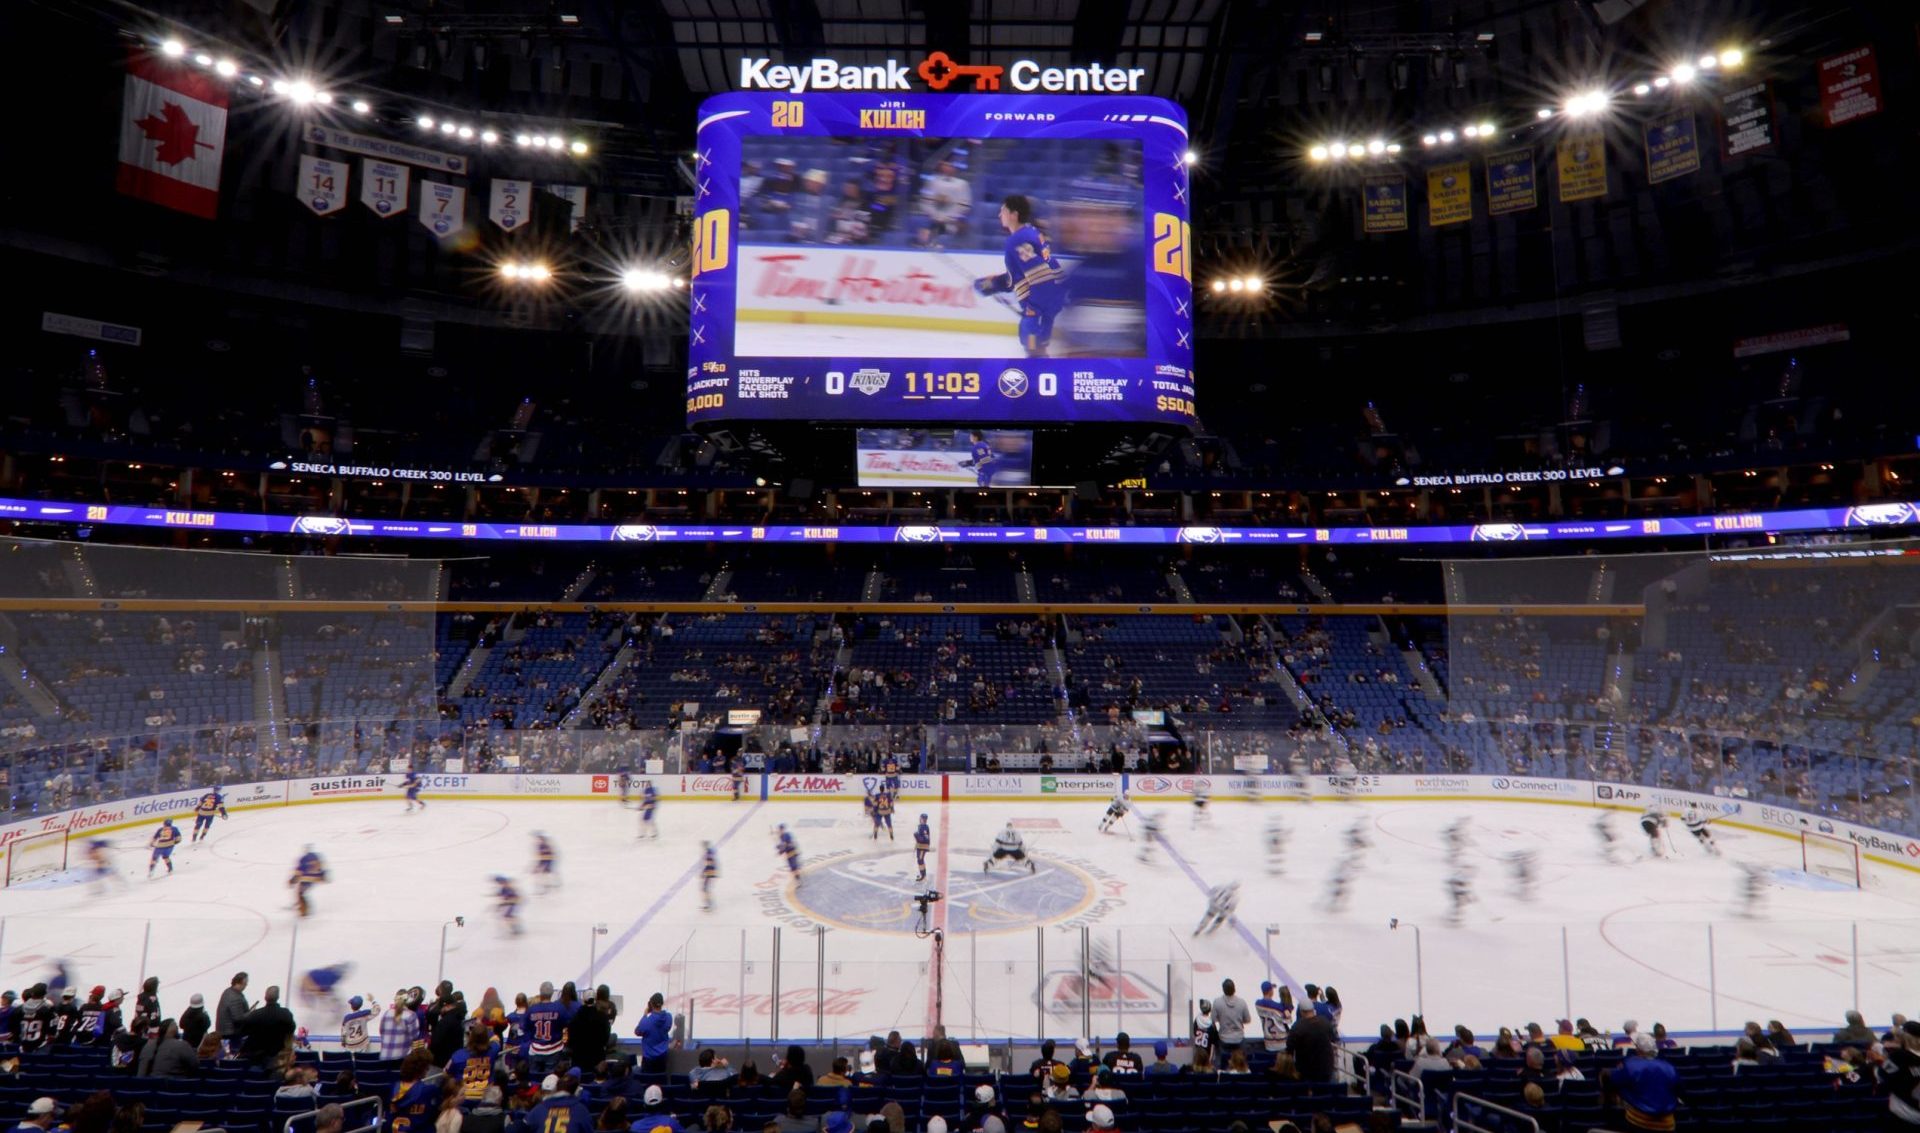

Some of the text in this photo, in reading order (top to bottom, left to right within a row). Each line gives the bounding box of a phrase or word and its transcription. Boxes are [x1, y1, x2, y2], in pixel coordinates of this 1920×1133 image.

[741, 58, 1144, 93] KeyBank Center
[772, 101, 803, 127] 20
[860, 110, 925, 129] KULICH
[985, 113, 1055, 121] FORWARD
[312, 175, 334, 192] 14
[376, 178, 396, 194] 11
[437, 199, 449, 213] 7
[503, 195, 517, 209] 2
[739, 369, 760, 377] HITS
[693, 378, 729, 390] JACKPOT
[826, 372, 844, 395] 0
[853, 378, 886, 386] KINGS
[906, 372, 980, 393] 11:03
[1039, 373, 1057, 396] 0
[1152, 381, 1180, 391] TOTAL
[292, 463, 485, 481] SENECA BUFFALO CREEK 300 LEVEL
[1414, 468, 1604, 485] SENECA BUFFALO CREEK 300 LEVEL
[87, 506, 107, 520] 20
[166, 512, 215, 526] KULICH
[1714, 515, 1763, 529] KULICH
[462, 525, 476, 536] 20
[519, 526, 557, 537] KULICH
[752, 527, 765, 539] 20
[804, 528, 838, 539] KULICH
[1034, 528, 1047, 540] 20
[1086, 528, 1120, 540] KULICH
[1316, 529, 1329, 541] 20
[1371, 529, 1407, 540] KULICH
[310, 776, 385, 791] austin air
[433, 777, 468, 787] CFBT
[775, 776, 840, 791] LA NOVA
[965, 777, 1022, 788] LECOM
[1415, 777, 1469, 787] northtown
[1615, 788, 1641, 800] App
[69, 811, 124, 829] Hortons
[1762, 807, 1795, 825] BFLO
[1849, 831, 1905, 855] KeyBank
[348, 1026, 363, 1038] 24
[534, 1020, 552, 1040] 11
[1194, 1030, 1209, 1048] 26
